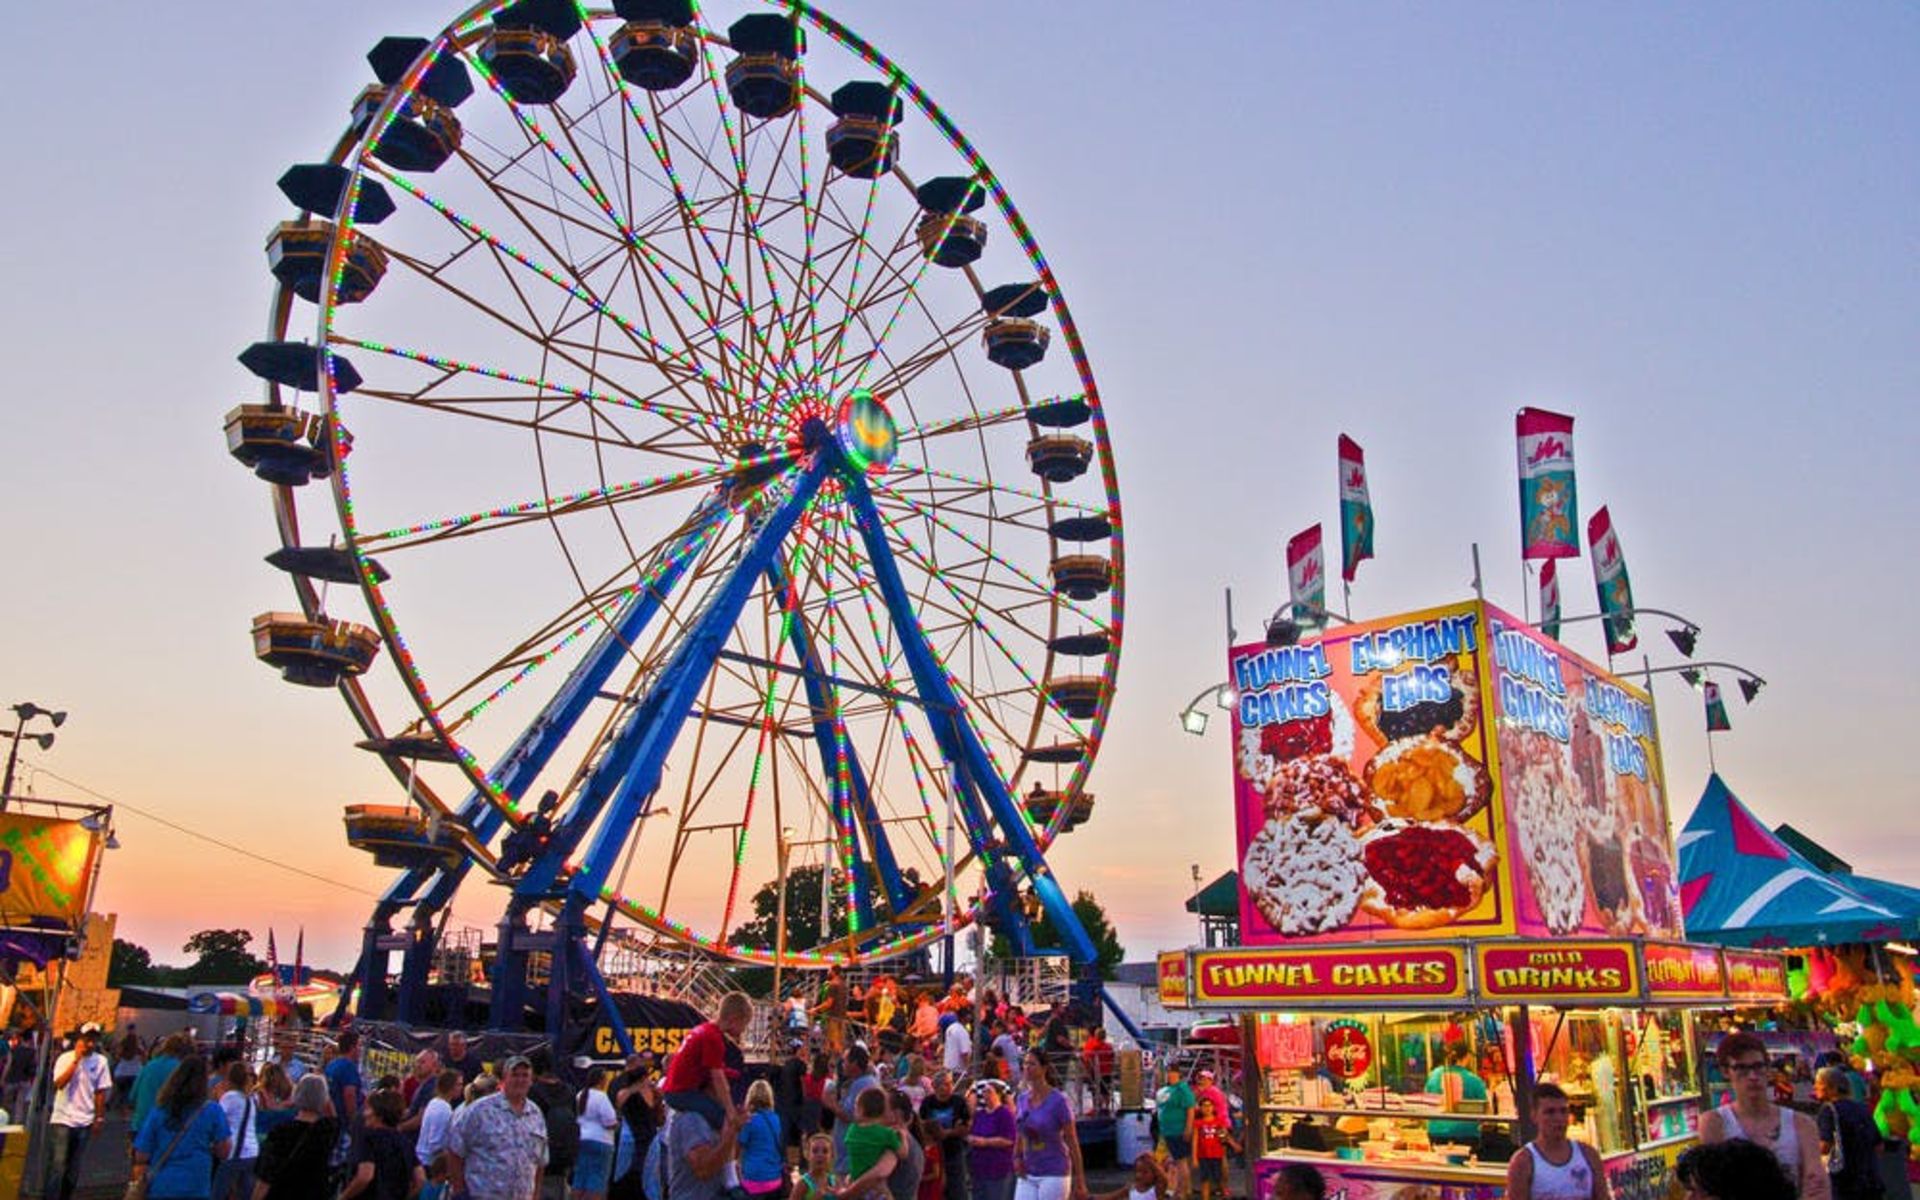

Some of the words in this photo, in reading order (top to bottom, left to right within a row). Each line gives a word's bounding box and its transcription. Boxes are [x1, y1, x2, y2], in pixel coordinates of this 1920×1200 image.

[1233, 643, 1333, 691] FUNNEL
[1350, 613, 1477, 675] ELEPHANT
[1490, 619, 1567, 696] FUNNEL
[1240, 680, 1330, 727] CAKES
[1382, 664, 1452, 711] EARS
[1501, 672, 1570, 744] CAKES
[1208, 962, 1321, 987] FUNNEL
[1332, 961, 1446, 986] CAKES
[1493, 966, 1622, 989] DRINKS
[1528, 951, 1583, 965] COLD
